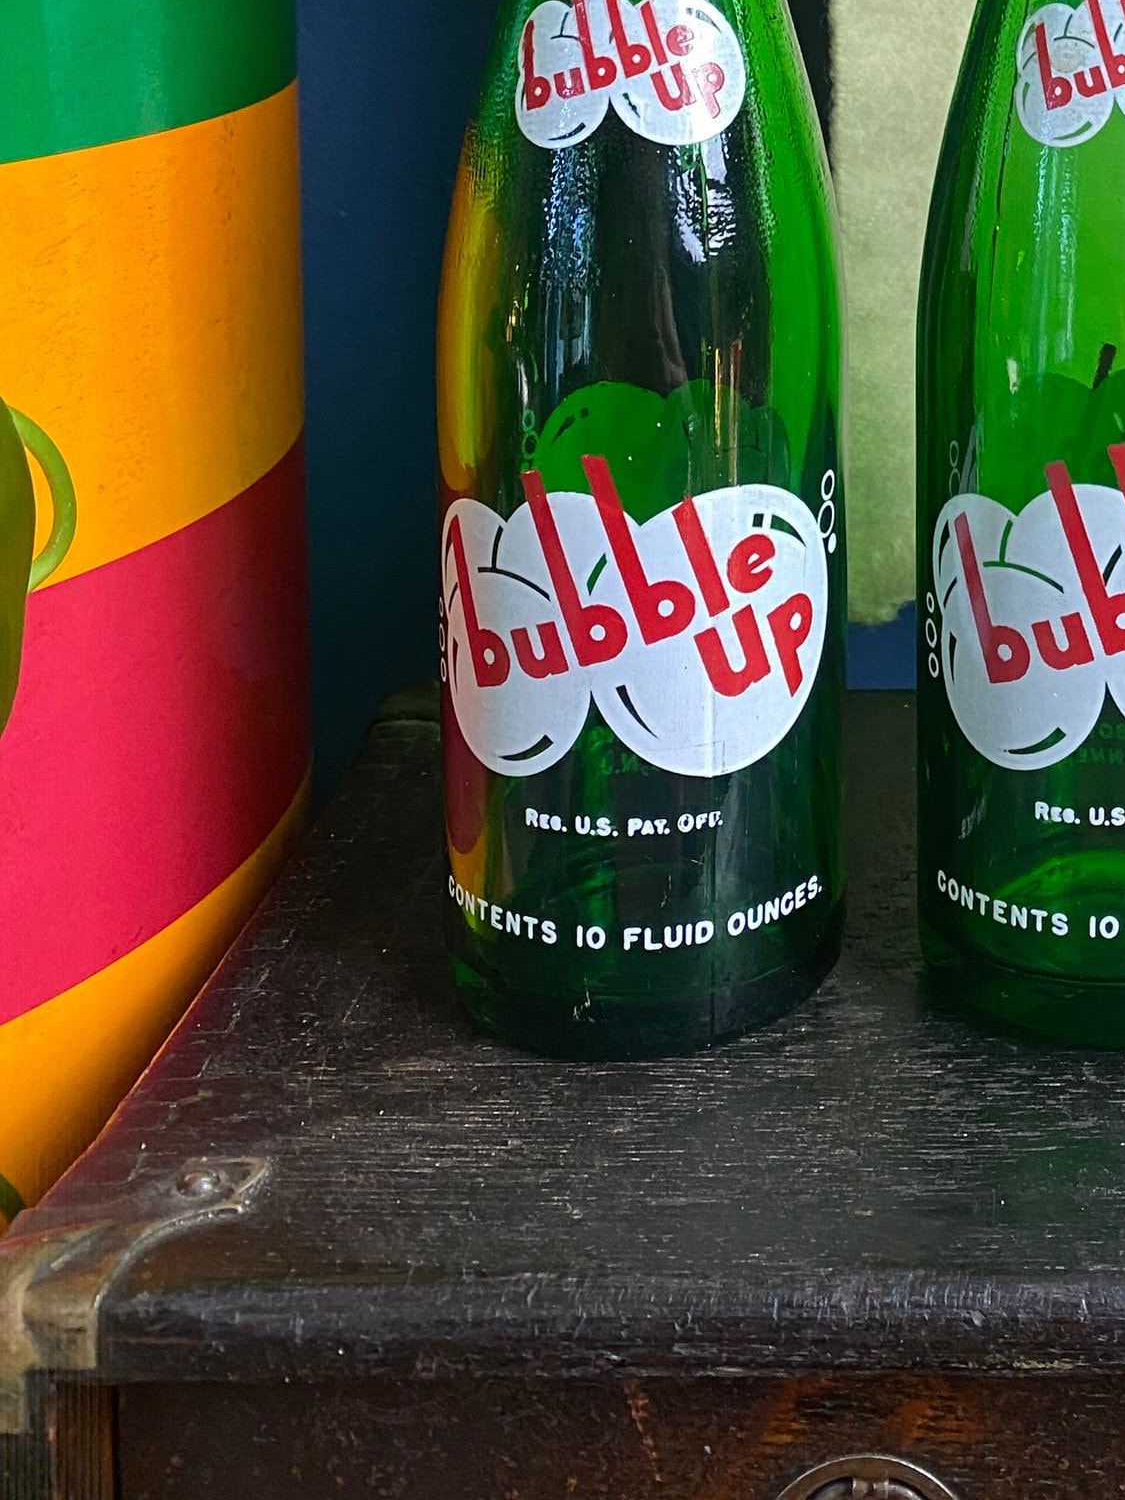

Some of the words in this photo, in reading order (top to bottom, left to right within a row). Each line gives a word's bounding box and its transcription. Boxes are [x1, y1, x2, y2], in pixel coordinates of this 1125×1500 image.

[449, 455, 777, 687] bubble
[575, 815, 618, 837] U.S.
[449, 875, 557, 945] CONTENTS
[623, 919, 714, 951] FLUID
[937, 870, 1068, 936] CONTENTS
